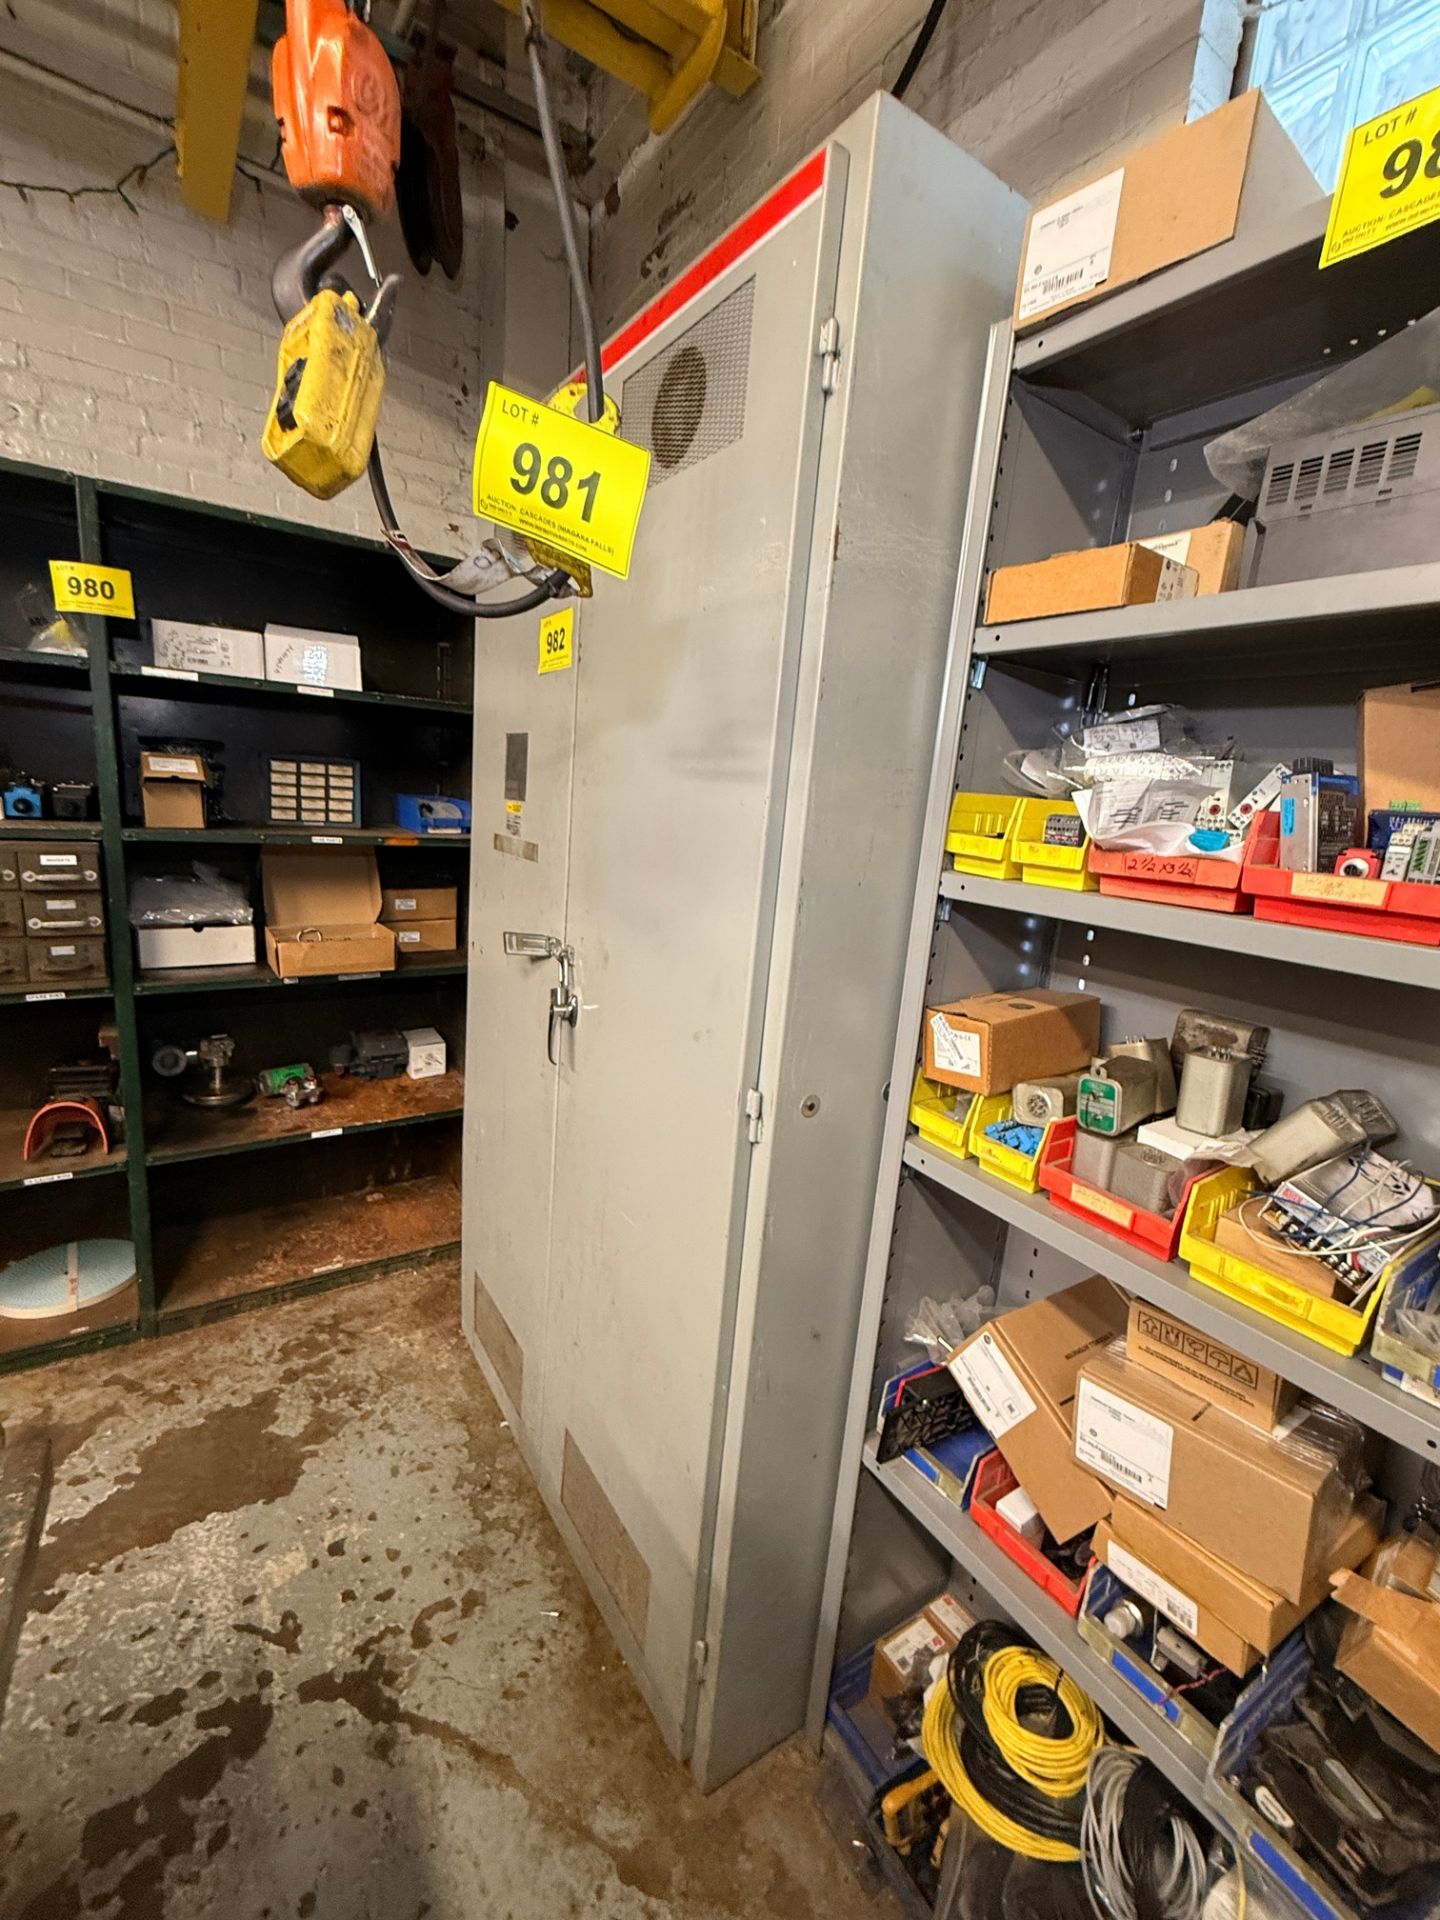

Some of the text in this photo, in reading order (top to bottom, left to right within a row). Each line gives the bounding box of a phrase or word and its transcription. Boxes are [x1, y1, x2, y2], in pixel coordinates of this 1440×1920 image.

[1364, 106, 1418, 146] LOT #
[502, 399, 540, 427] LOT #
[510, 442, 602, 523] 981
[519, 507, 556, 529] CASCADES
[67, 576, 115, 600] 980
[546, 627, 566, 655] 982
[1127, 858, 1138, 870] 2
